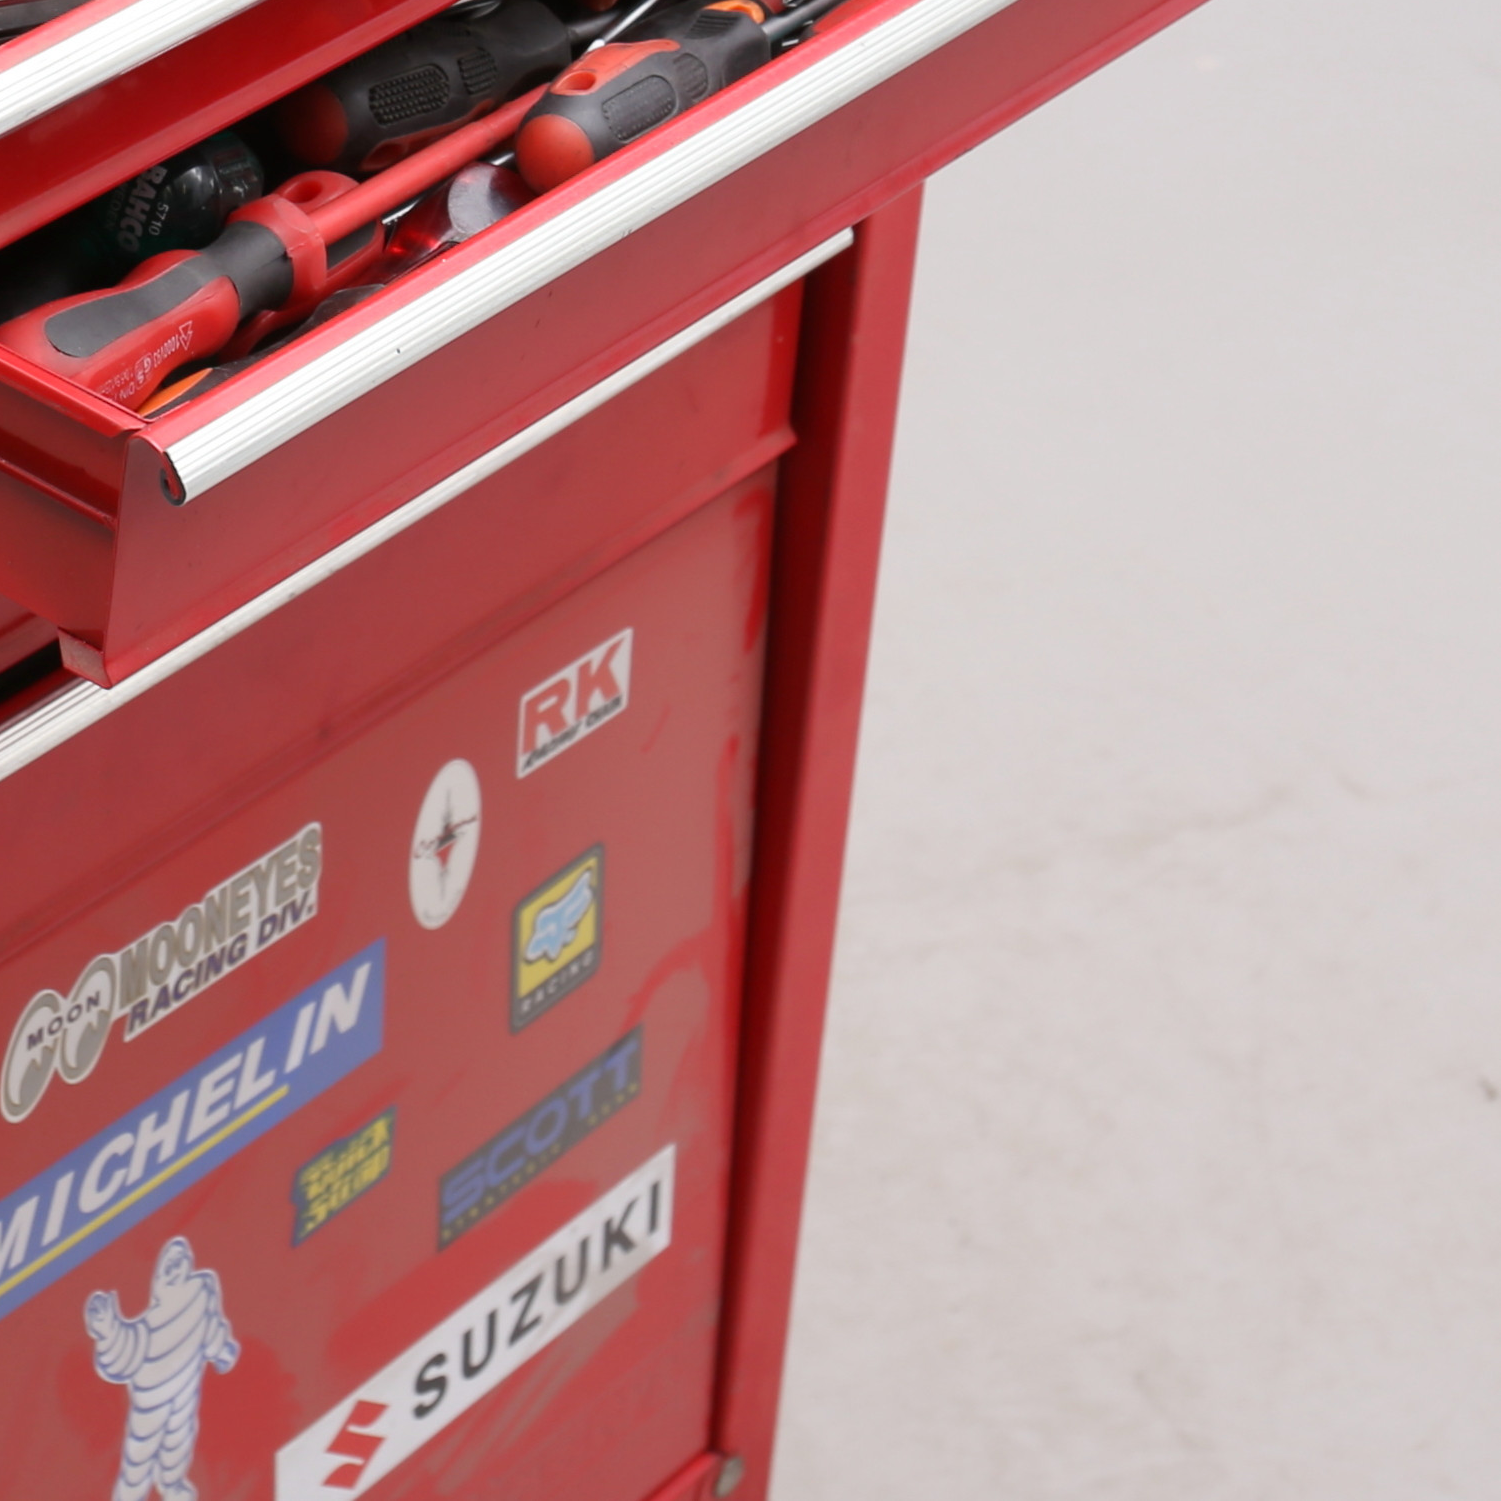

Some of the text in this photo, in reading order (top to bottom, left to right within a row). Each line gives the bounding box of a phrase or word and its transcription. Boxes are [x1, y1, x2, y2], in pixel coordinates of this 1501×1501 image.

[116, 165, 168, 253] BAHCO
[149, 201, 170, 236] 5710
[522, 637, 625, 756] RK
[118, 827, 319, 1003] MOONEYES
[127, 888, 315, 1033] RACING DIV.
[26, 990, 101, 1051] MOON
[441, 1038, 640, 1225] SCOTT
[412, 1180, 662, 1420] SUZUKI
